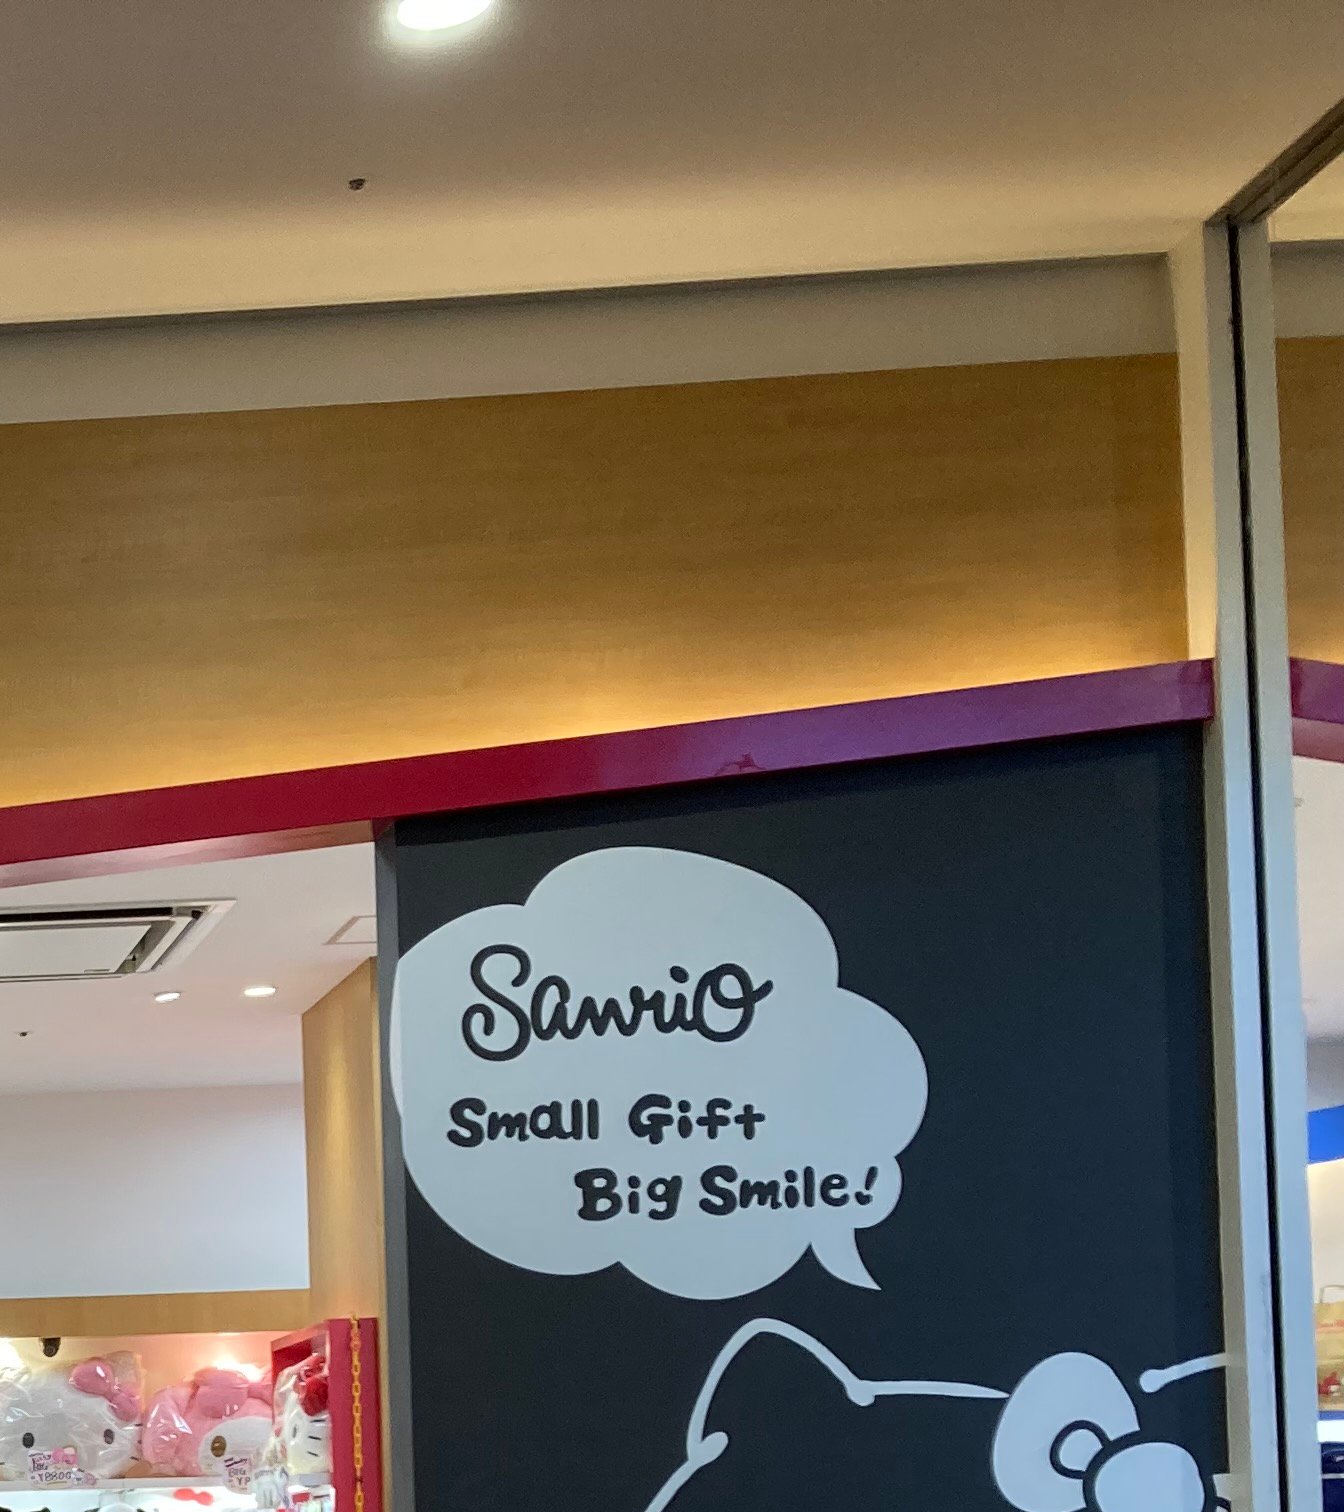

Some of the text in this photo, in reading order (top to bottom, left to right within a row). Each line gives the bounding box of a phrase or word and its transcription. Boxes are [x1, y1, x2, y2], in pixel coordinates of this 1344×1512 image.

[462, 943, 773, 1061] Sanrio
[447, 1094, 765, 1148] Small Gift
[574, 1165, 879, 1221] Big Smile!
